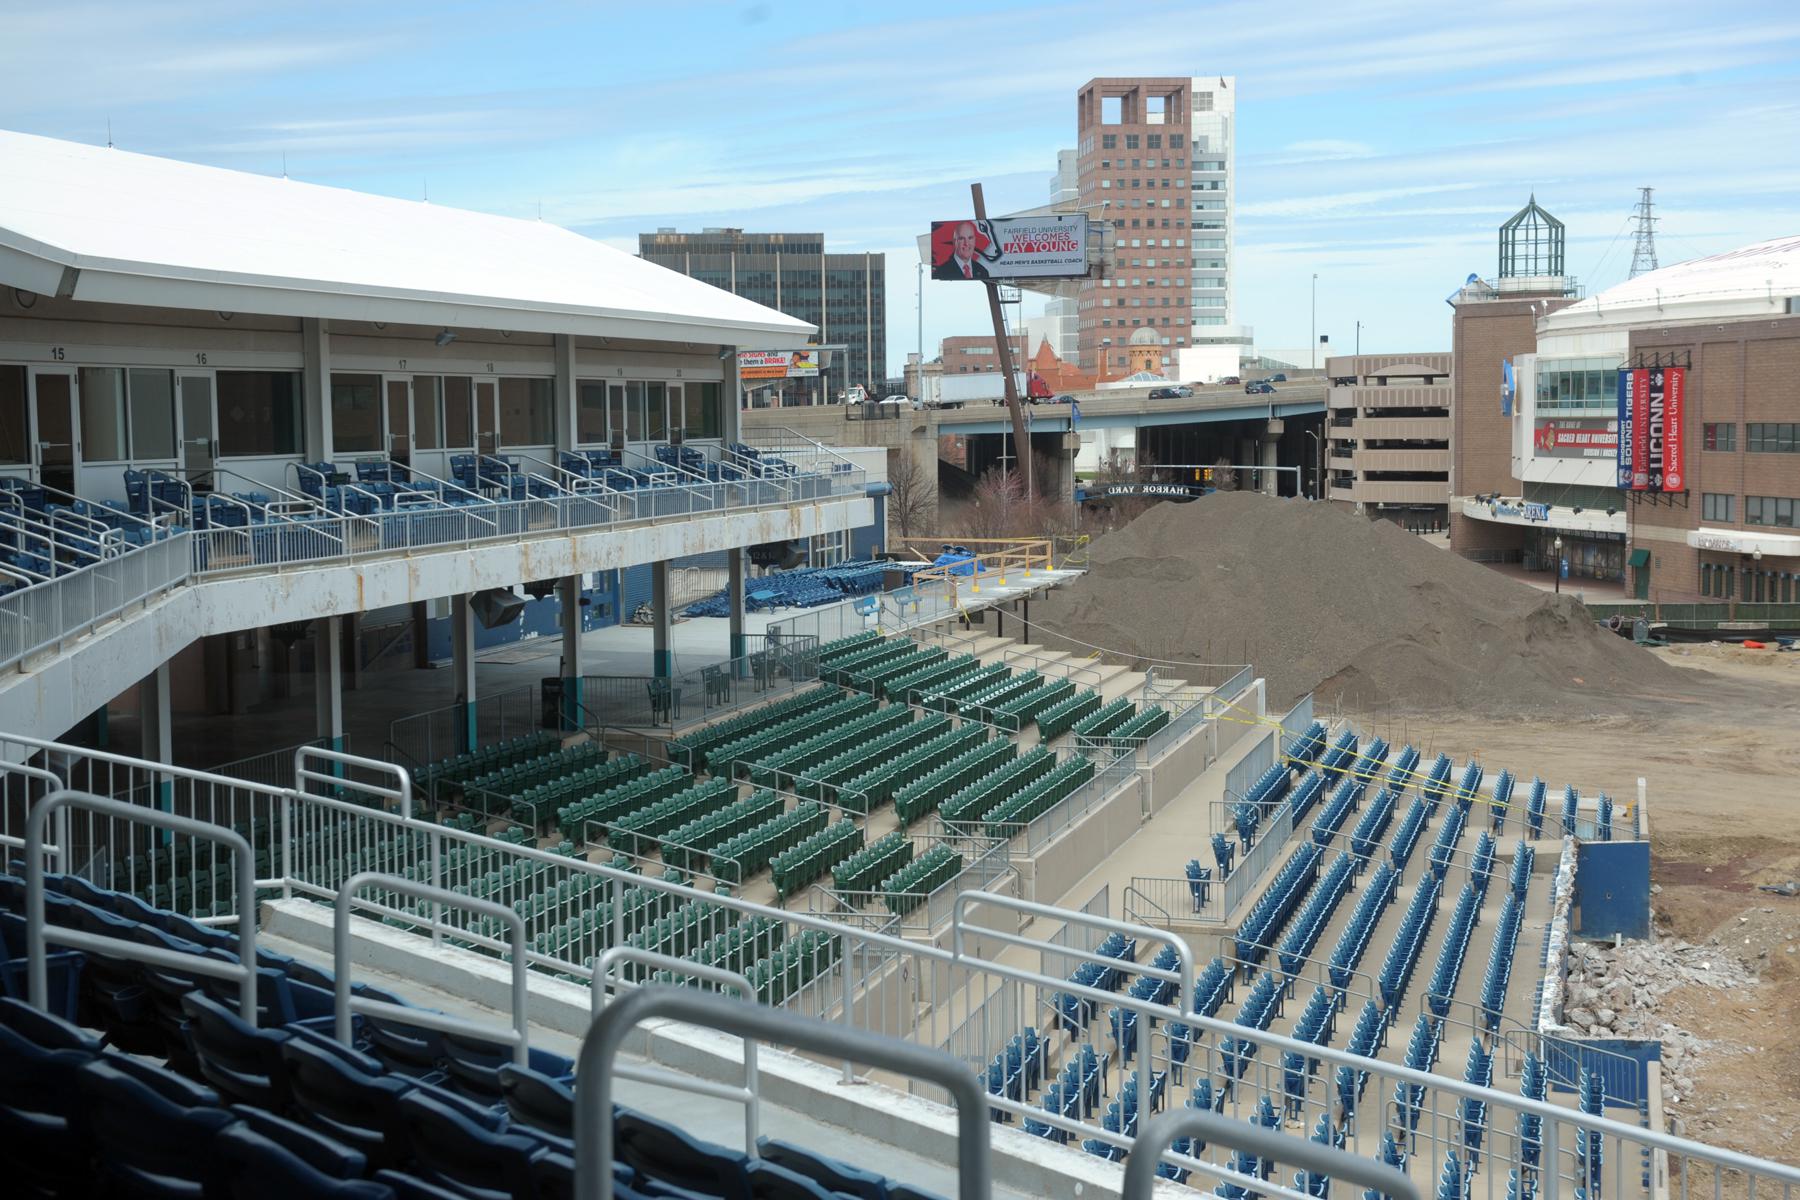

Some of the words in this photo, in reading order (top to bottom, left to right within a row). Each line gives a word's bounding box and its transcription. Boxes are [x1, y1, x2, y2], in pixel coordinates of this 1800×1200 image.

[1003, 227, 1037, 235] FAIRFIELD
[1038, 225, 1078, 233] UNIVERSITY
[1012, 232, 1071, 242] WELCOMES
[1004, 242, 1027, 254] JAY
[1031, 240, 1078, 252] YOUNG
[51, 347, 65, 361] 15
[195, 352, 207, 365] 16
[398, 359, 407, 369] 17
[1626, 372, 1634, 418] TIGERS
[1640, 377, 1648, 434] UNIVERSITY
[1668, 371, 1681, 415] University
[1557, 432, 1576, 443] SACRED
[1575, 433, 1591, 444] HEART
[1650, 392, 1664, 468] UCONN
[1668, 417, 1678, 442] Heart
[1625, 420, 1633, 466] SOUND
[1639, 435, 1647, 472] Fairfield
[1668, 444, 1678, 472] Sacred
